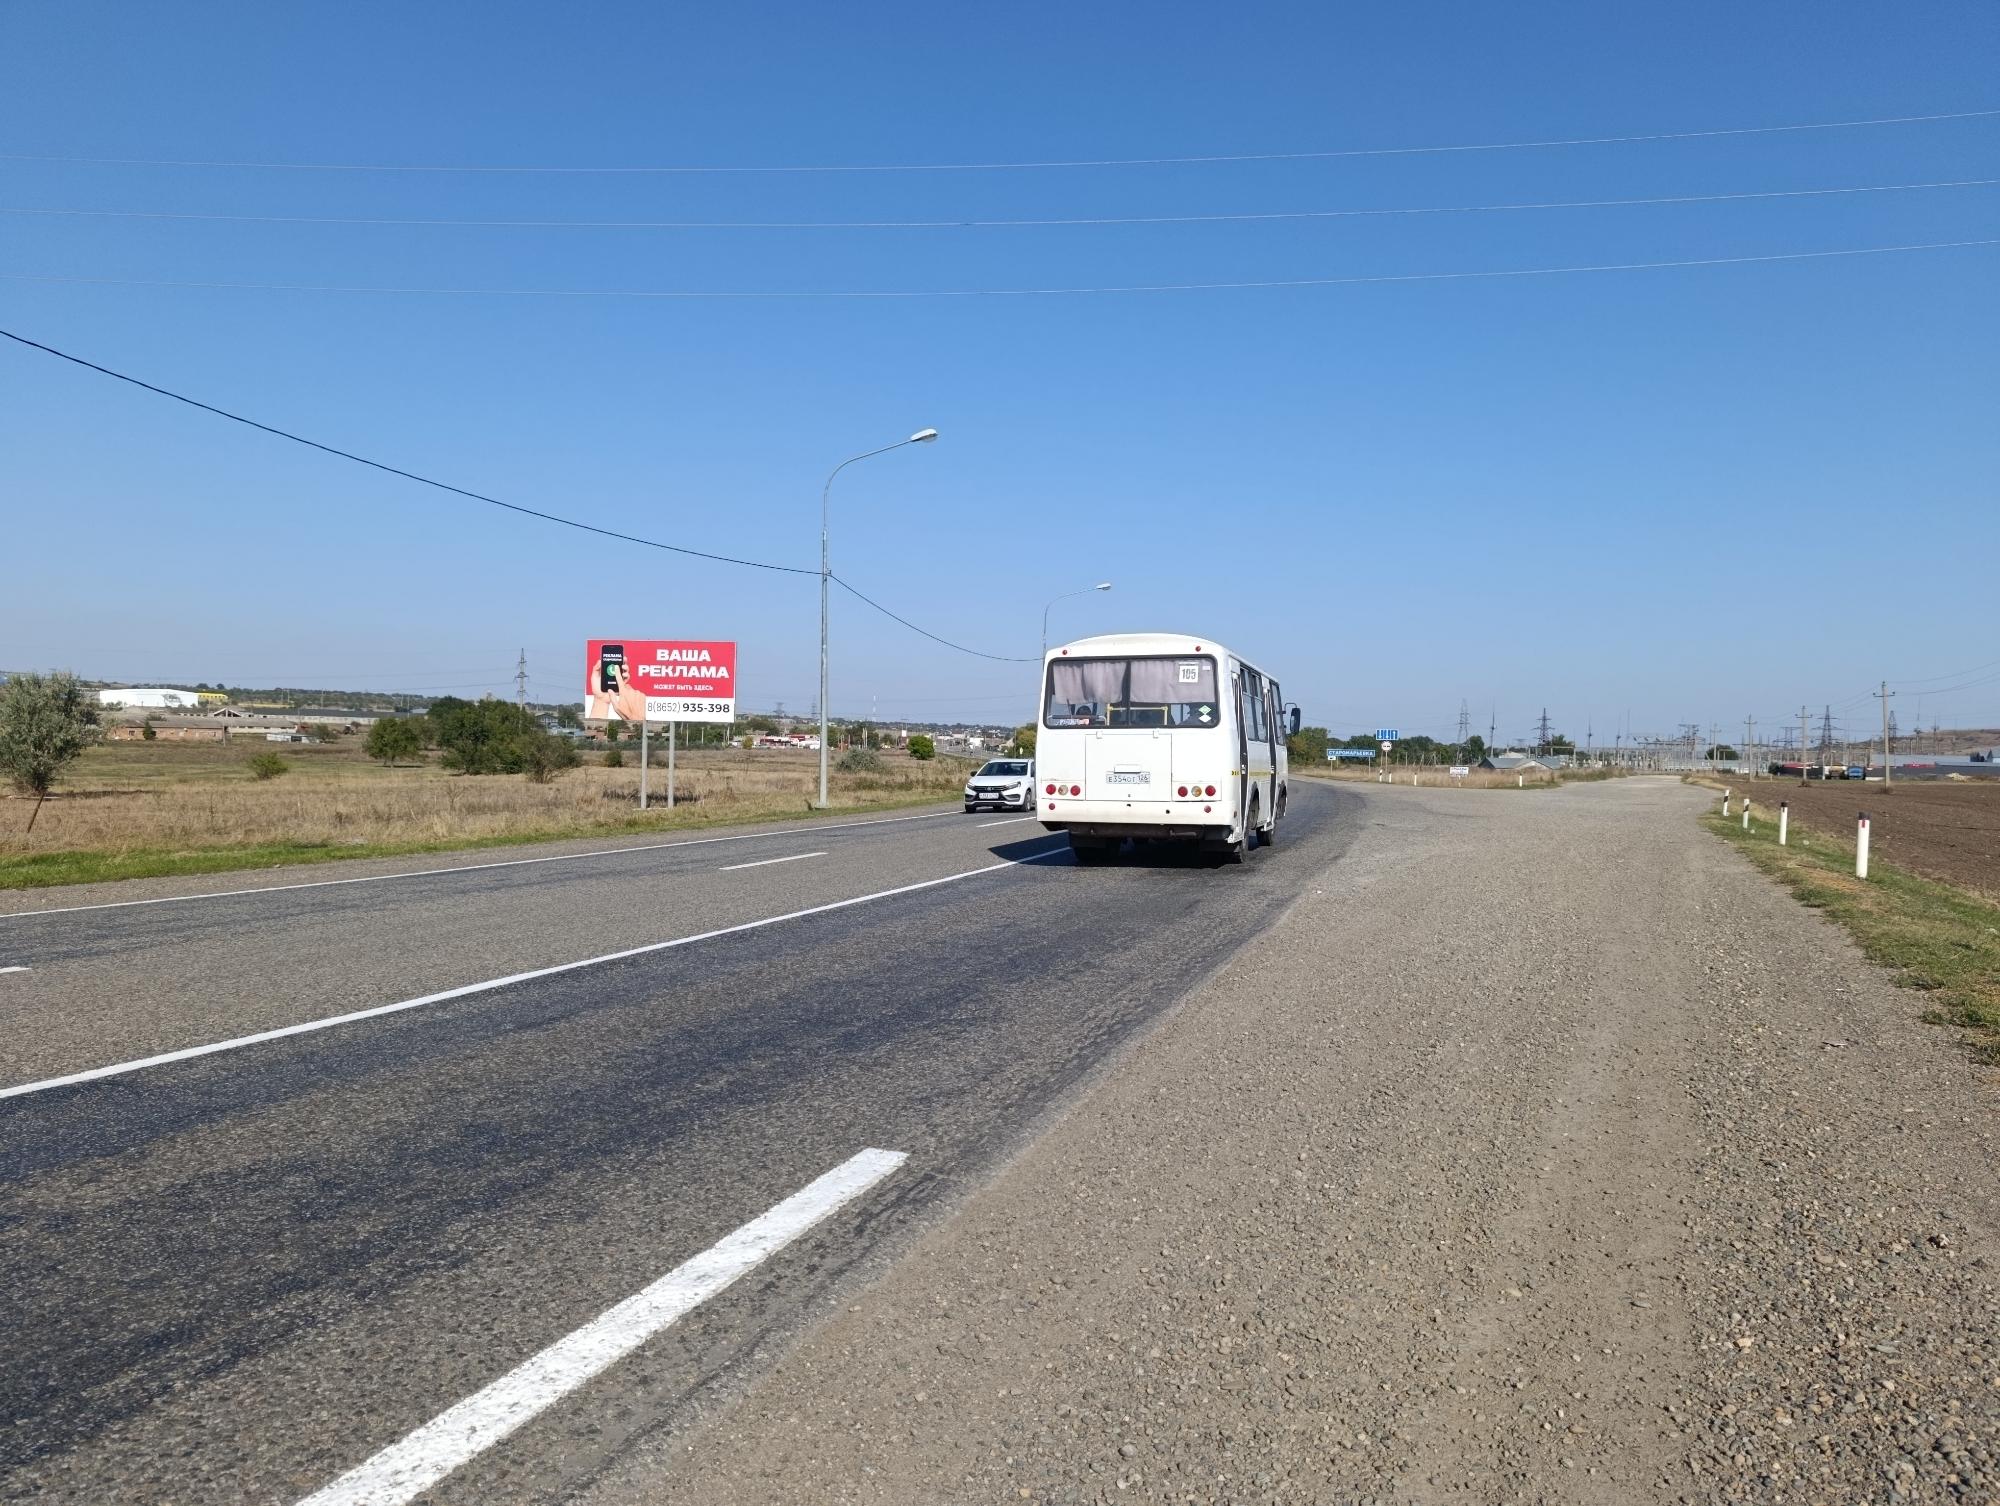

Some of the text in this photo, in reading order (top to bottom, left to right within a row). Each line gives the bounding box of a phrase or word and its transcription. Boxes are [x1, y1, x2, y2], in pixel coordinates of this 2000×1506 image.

[656, 649, 711, 661] ВАША
[638, 665, 729, 678] РЕКЛАМА
[1182, 668, 1196, 680] 105
[647, 701, 730, 714] 8(8652) 935-398
